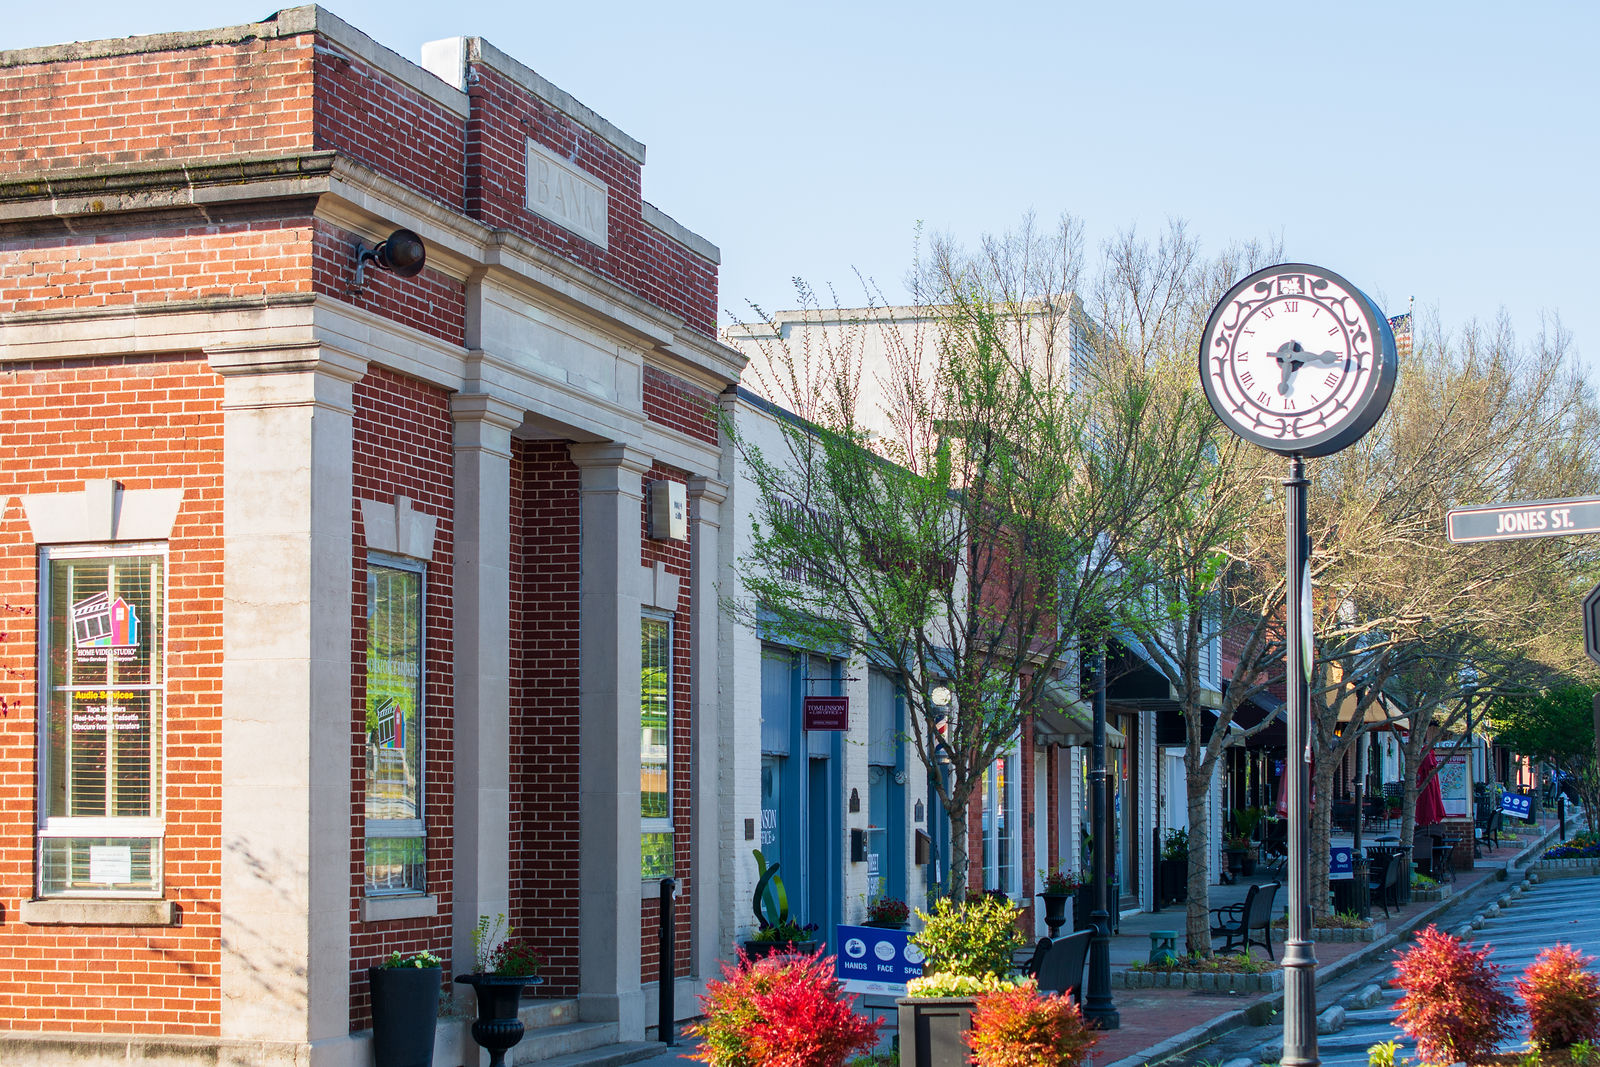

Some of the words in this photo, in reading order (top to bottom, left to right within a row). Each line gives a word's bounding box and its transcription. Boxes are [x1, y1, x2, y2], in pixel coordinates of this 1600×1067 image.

[537, 158, 597, 234] BANK
[1284, 301, 1299, 313] XII
[1261, 307, 1275, 321] XI
[1243, 327, 1256, 338] X
[1328, 326, 1340, 337] II
[1237, 351, 1249, 362] IX
[1239, 371, 1256, 391] VIII
[1256, 391, 1272, 407] VII
[1283, 398, 1296, 410] VI
[1310, 394, 1319, 406] V
[1496, 511, 1548, 533] JONES
[1551, 508, 1575, 529] ST.
[75, 691, 98, 699] Audio
[844, 961, 868, 970] HANDS
[877, 964, 894, 973] FACE
